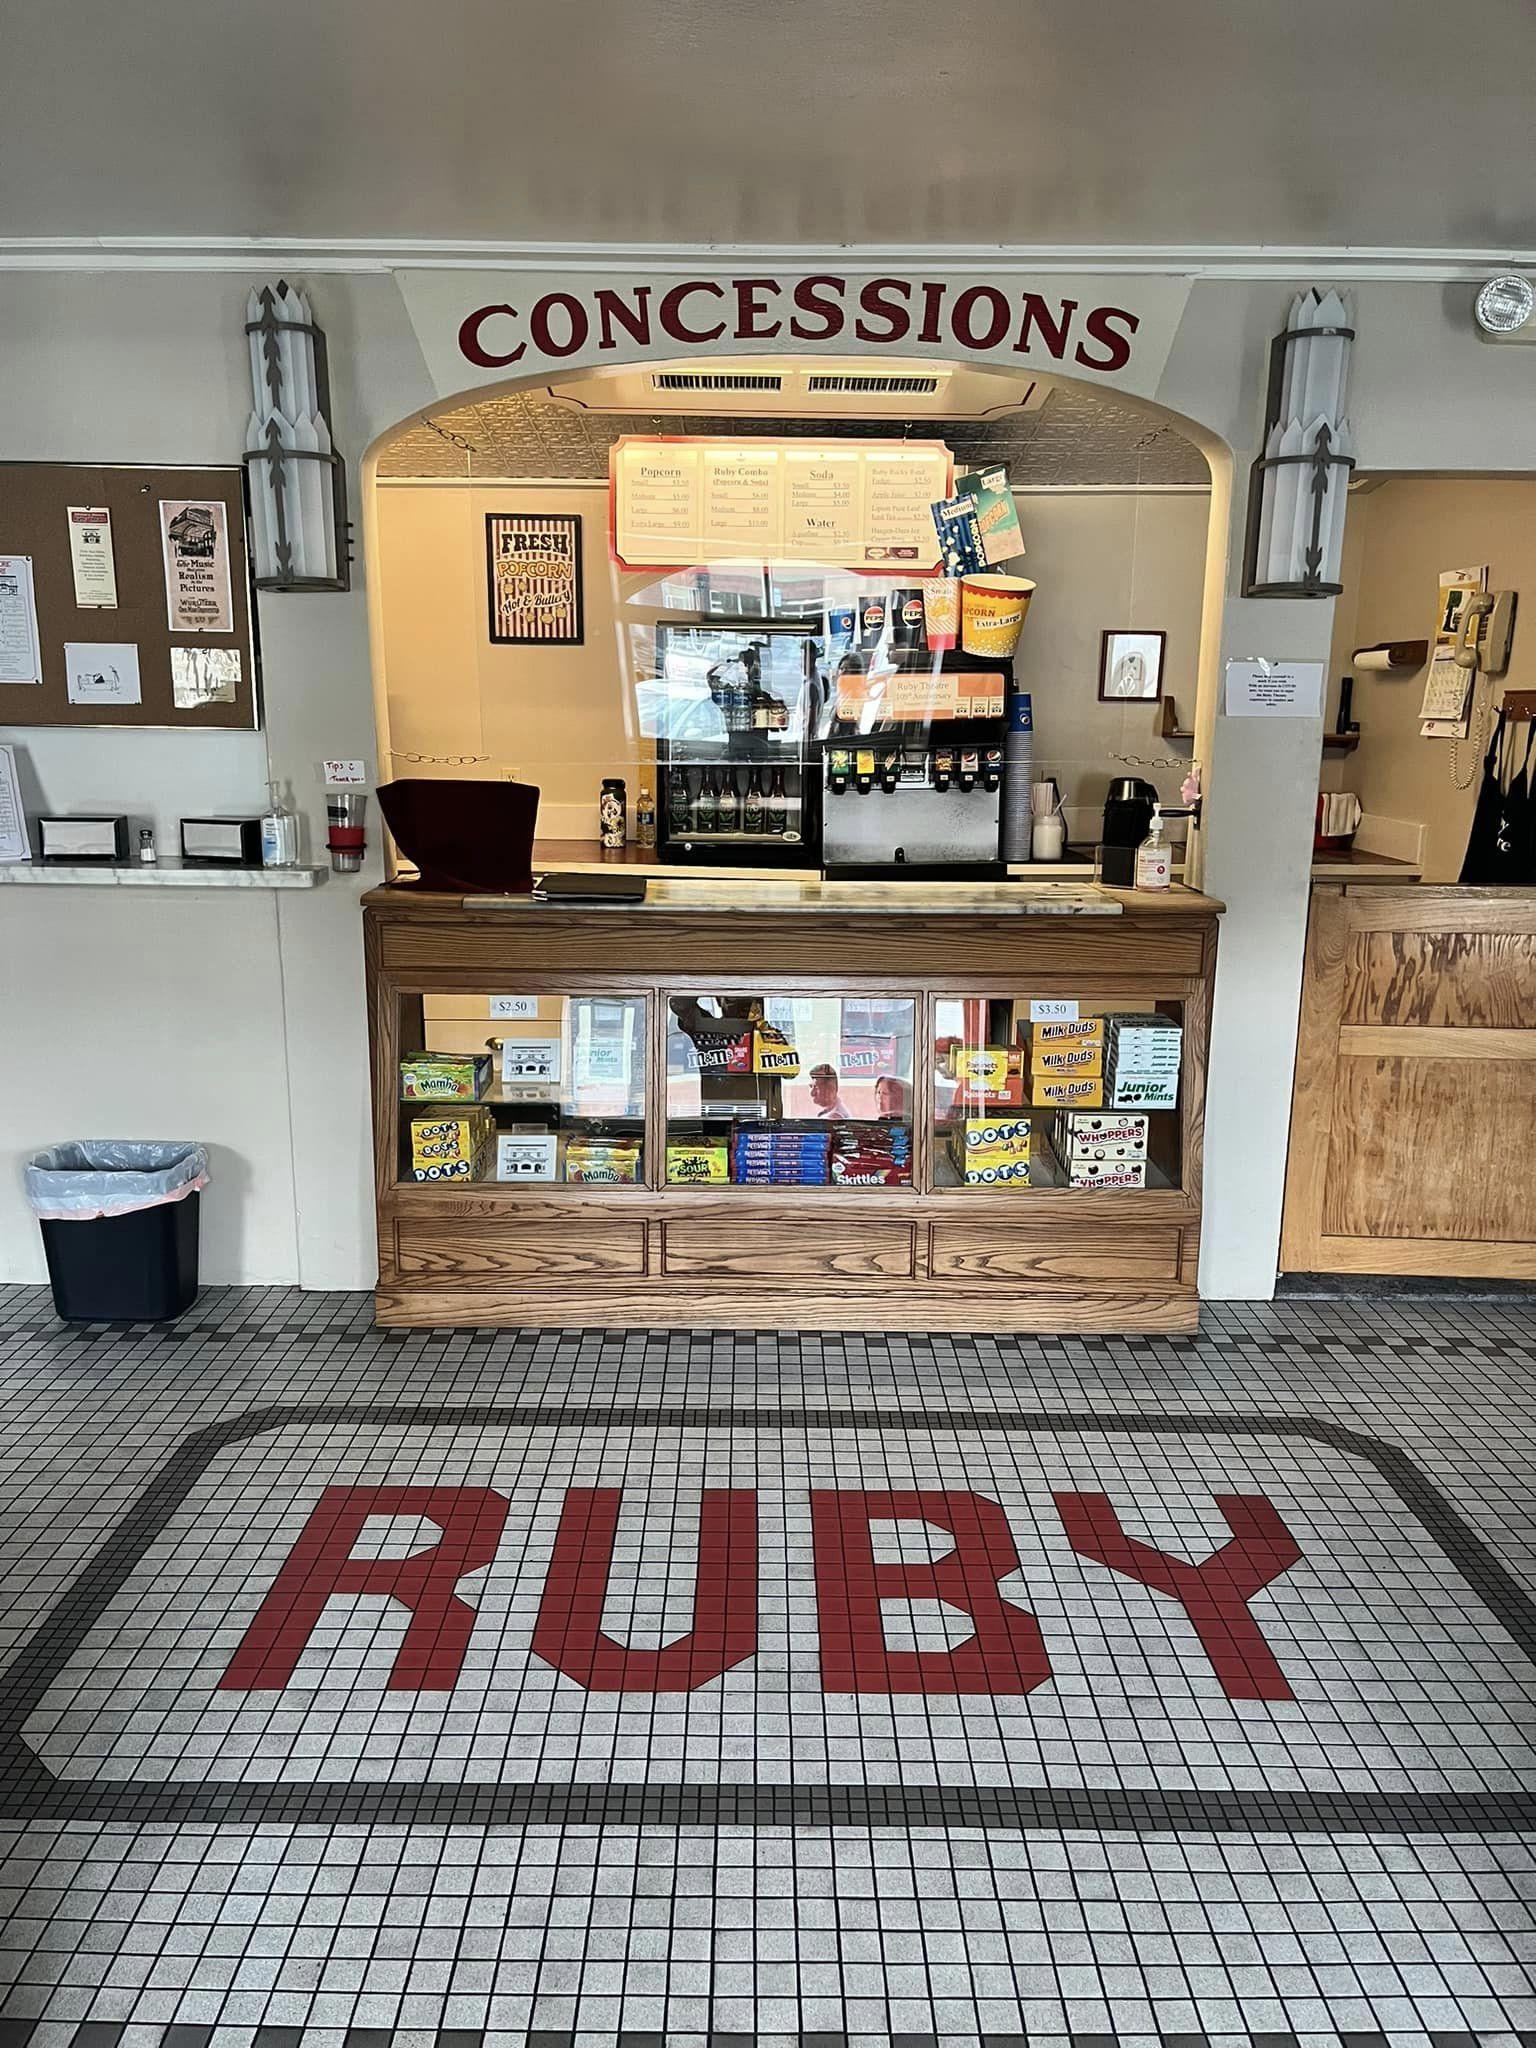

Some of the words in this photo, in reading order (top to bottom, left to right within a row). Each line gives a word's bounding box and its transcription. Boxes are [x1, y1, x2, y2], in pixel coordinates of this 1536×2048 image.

[458, 276, 1139, 372] CONCESSIONS
[640, 467, 681, 478] Popcorn
[714, 467, 735, 477] Ruby
[737, 467, 768, 476] Combo
[810, 469, 834, 480] Soda
[942, 503, 972, 517] Medium
[807, 518, 835, 528] Water
[501, 534, 568, 554] FRESH
[968, 519, 987, 567] POPCORN
[497, 561, 571, 579] POPCORN
[180, 584, 214, 592] Pictures
[502, 597, 520, 615] Hot
[523, 594, 532, 606] &
[535, 590, 570, 606] Buttery
[976, 614, 1020, 627] Extra-Large
[897, 682, 918, 691] Ruby
[326, 762, 343, 772] Tips
[499, 1001, 527, 1012] $2.50
[1038, 1004, 1067, 1015] $3.50
[1041, 1025, 1066, 1039] Milk
[1068, 1021, 1096, 1035] Duds
[1042, 1055, 1065, 1068] Milk
[1067, 1050, 1094, 1064] Duds
[420, 1077, 458, 1092] Mamba
[1043, 1085, 1065, 1098] Milk
[1068, 1080, 1095, 1095] Duds
[1117, 1081, 1167, 1093] Junior
[1144, 1092, 1174, 1101] Mints
[422, 1121, 459, 1137] DOTS
[966, 1121, 1031, 1146] DOTS
[1080, 1127, 1142, 1142] WHOPPERS
[414, 1160, 470, 1181] DOTS
[583, 1166, 620, 1182] Mamba
[679, 1164, 708, 1174] SOUR
[966, 1162, 1030, 1184] DOTS
[837, 1174, 886, 1185] Skittles
[216, 1486, 1305, 1702] RUBY
